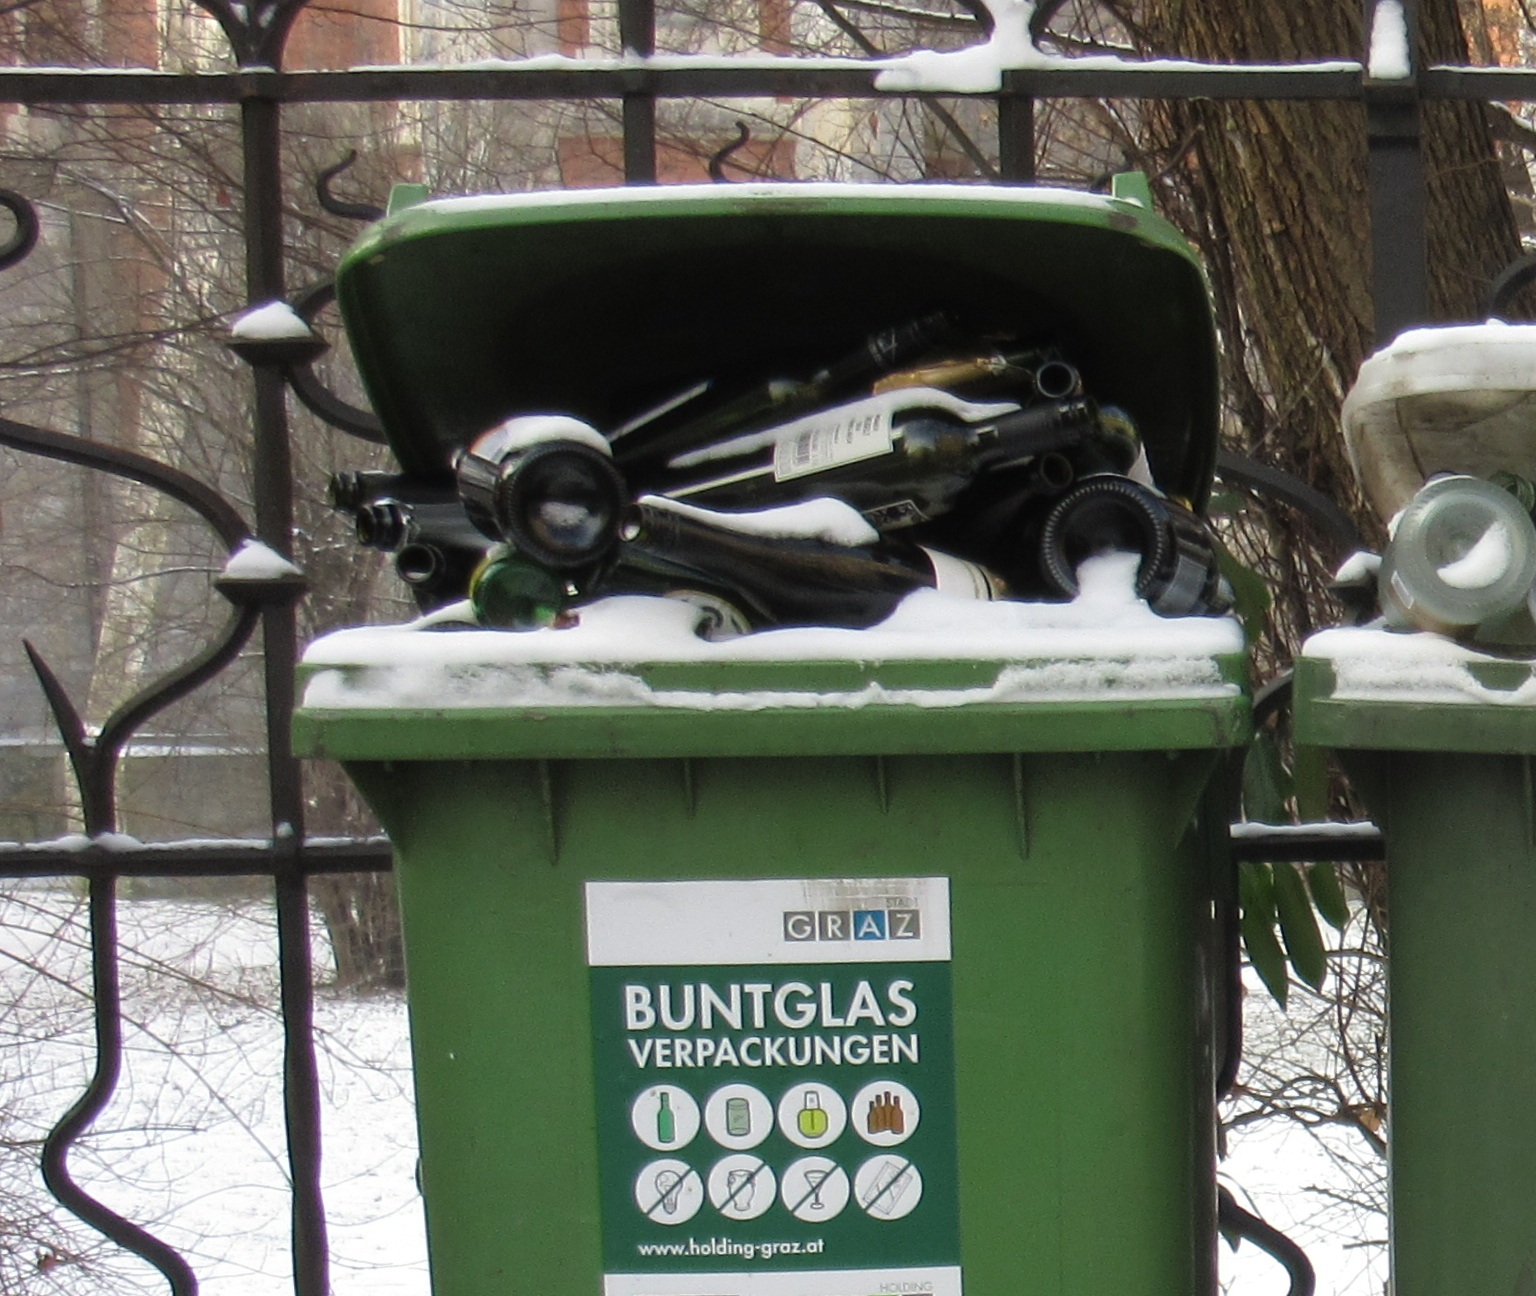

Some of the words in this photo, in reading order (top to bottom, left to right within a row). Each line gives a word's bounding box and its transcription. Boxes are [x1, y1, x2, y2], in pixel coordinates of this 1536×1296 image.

[784, 912, 917, 940] GRAZ
[625, 980, 917, 1031] BUNTGLAS
[628, 1034, 919, 1068] VERPACKUNGEN
[638, 1238, 824, 1259] www.holding-graz.at
[879, 1282, 933, 1293] HOLDING
